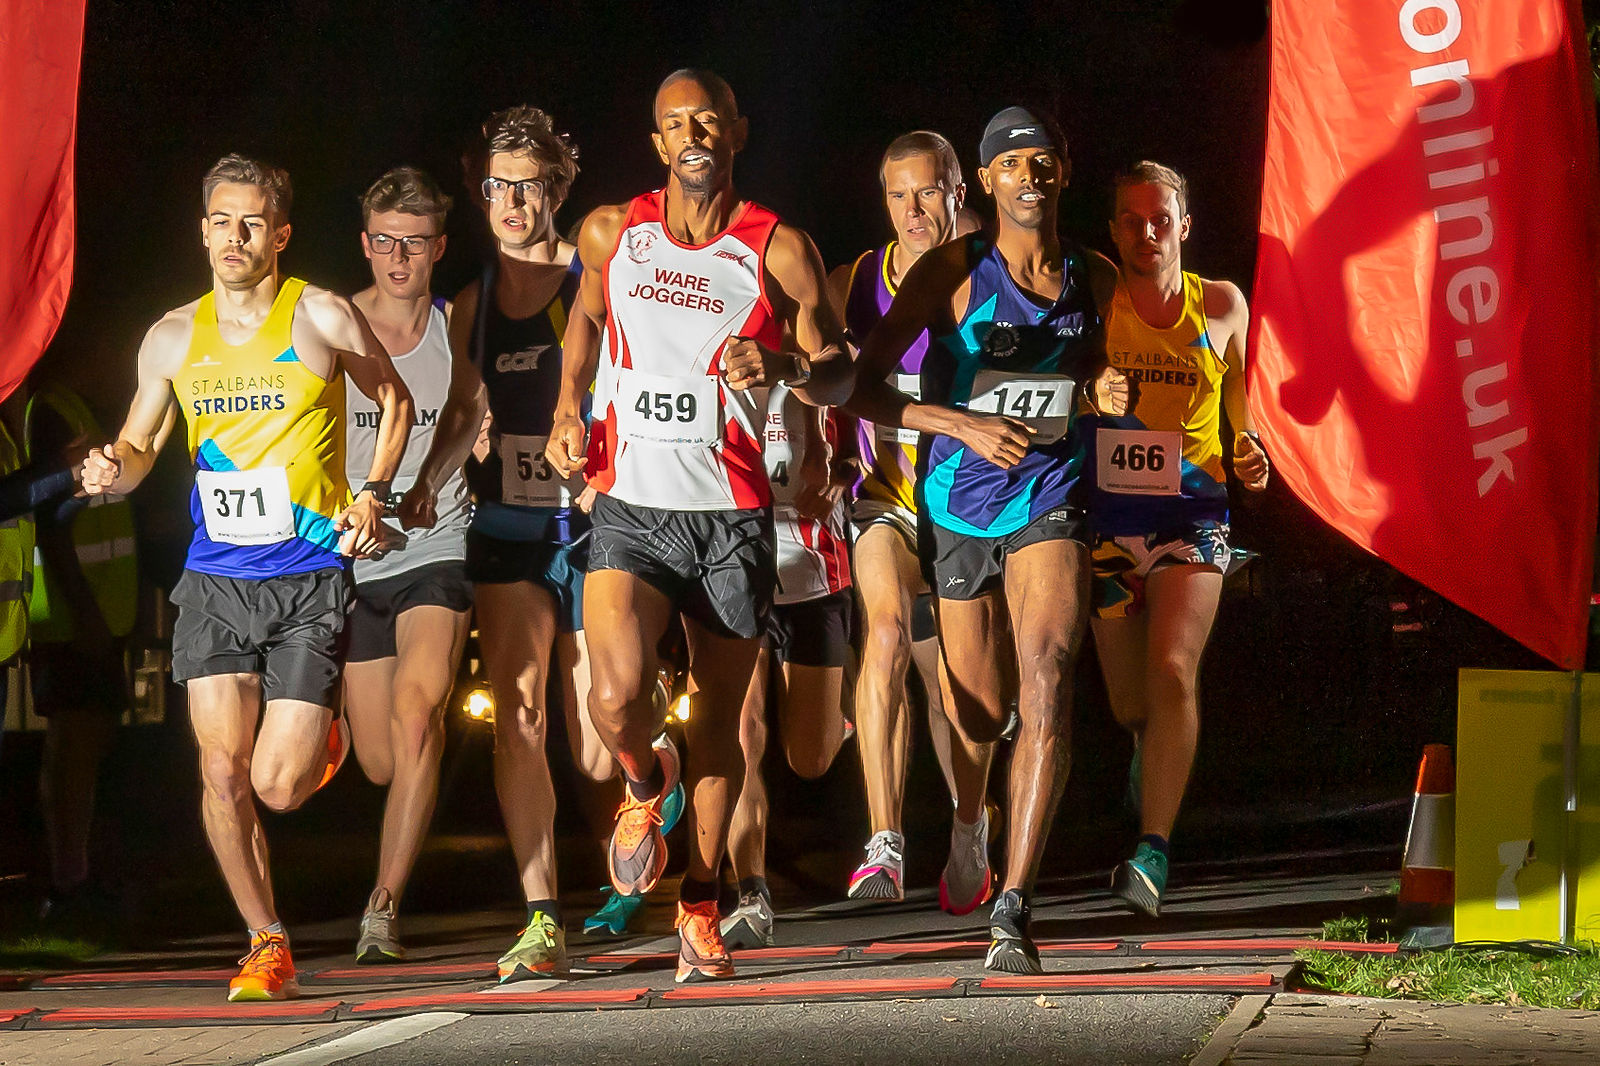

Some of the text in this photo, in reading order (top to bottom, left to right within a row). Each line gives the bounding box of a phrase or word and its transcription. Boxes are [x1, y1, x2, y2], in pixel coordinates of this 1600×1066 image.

[655, 268, 711, 293] WARE
[628, 284, 725, 314] JOGGERS
[1113, 352, 1198, 368] ST ALBANS
[192, 374, 285, 395] ST ALBANS
[1120, 367, 1197, 386] TRIDERS
[193, 394, 285, 416] STRIDERS
[634, 391, 697, 423] 459
[993, 388, 1056, 418] 147
[354, 409, 438, 428] DUM
[516, 452, 553, 481] 53
[1110, 444, 1165, 472] 466
[213, 487, 266, 517] 371
